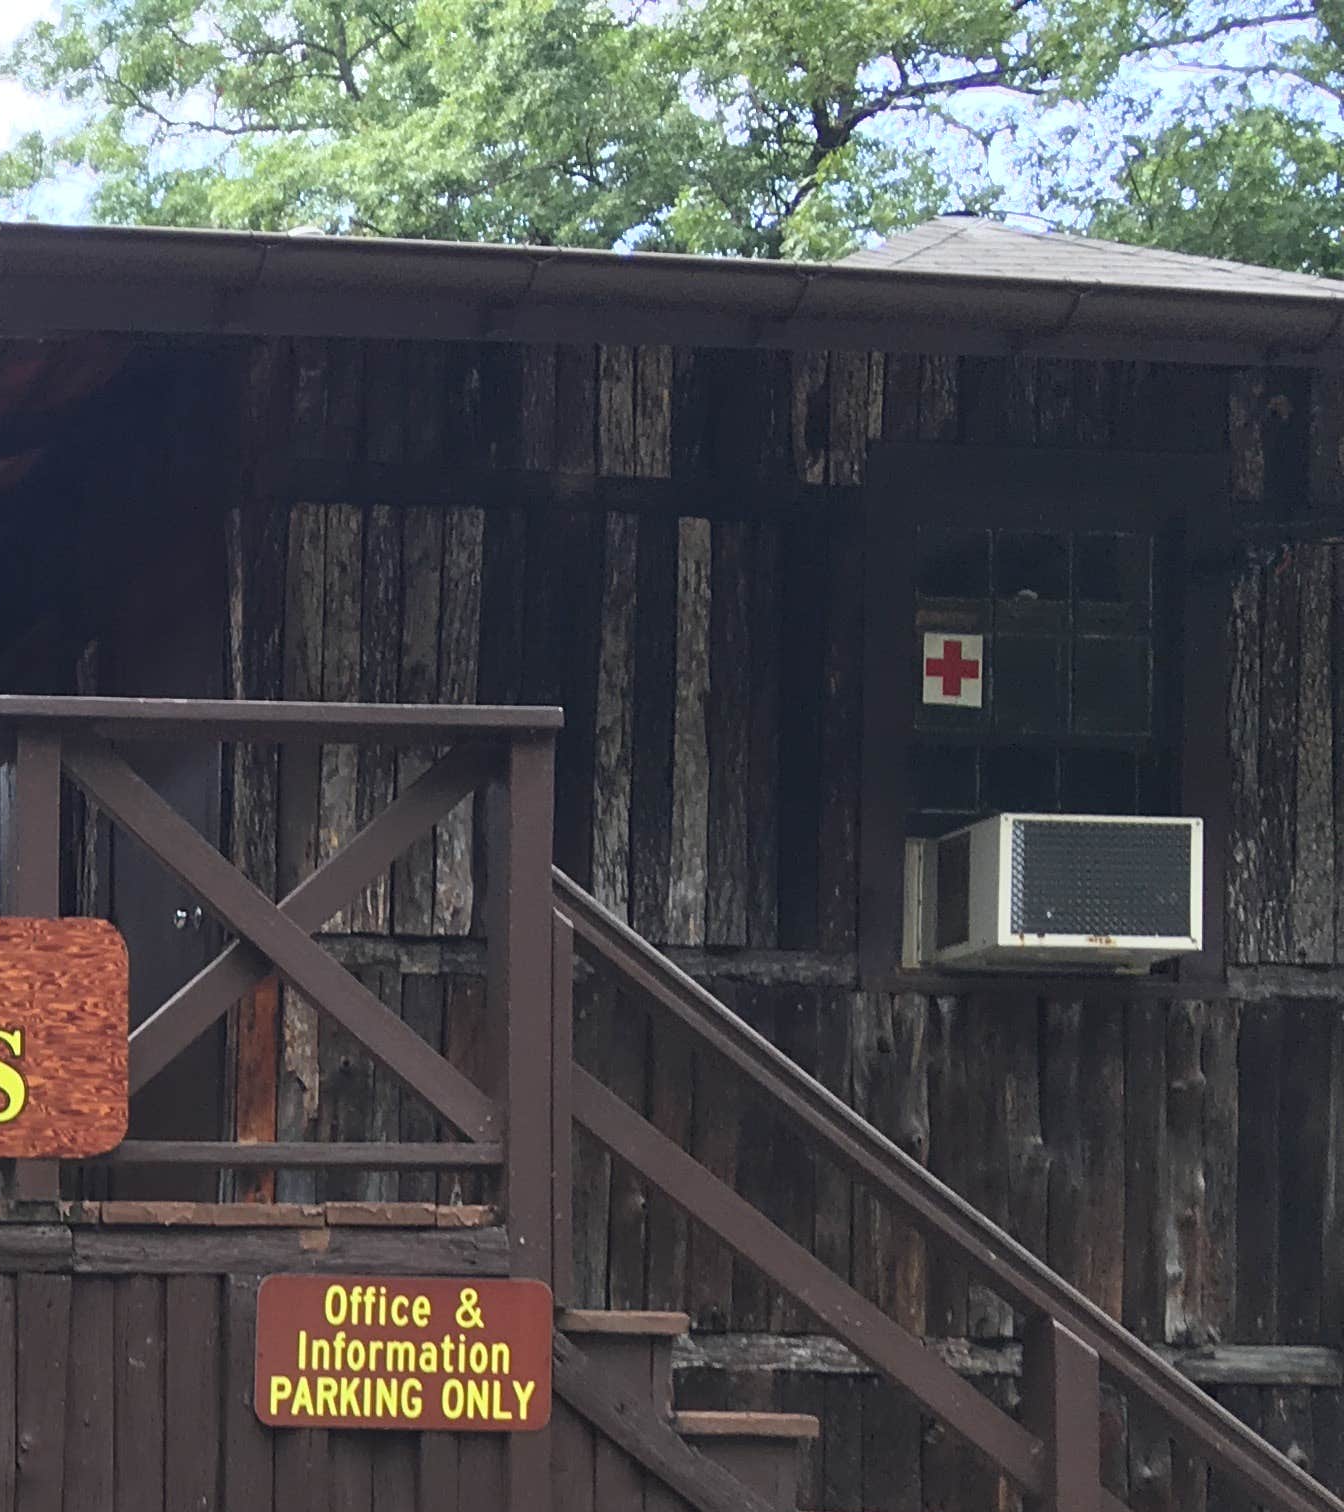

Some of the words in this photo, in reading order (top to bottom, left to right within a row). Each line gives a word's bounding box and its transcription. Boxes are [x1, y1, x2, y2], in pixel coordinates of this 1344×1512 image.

[324, 1284, 431, 1328] Office
[455, 1288, 485, 1329] &
[298, 1330, 510, 1375] Information
[270, 1375, 423, 1419] PARKING
[441, 1378, 536, 1421] ONLY
